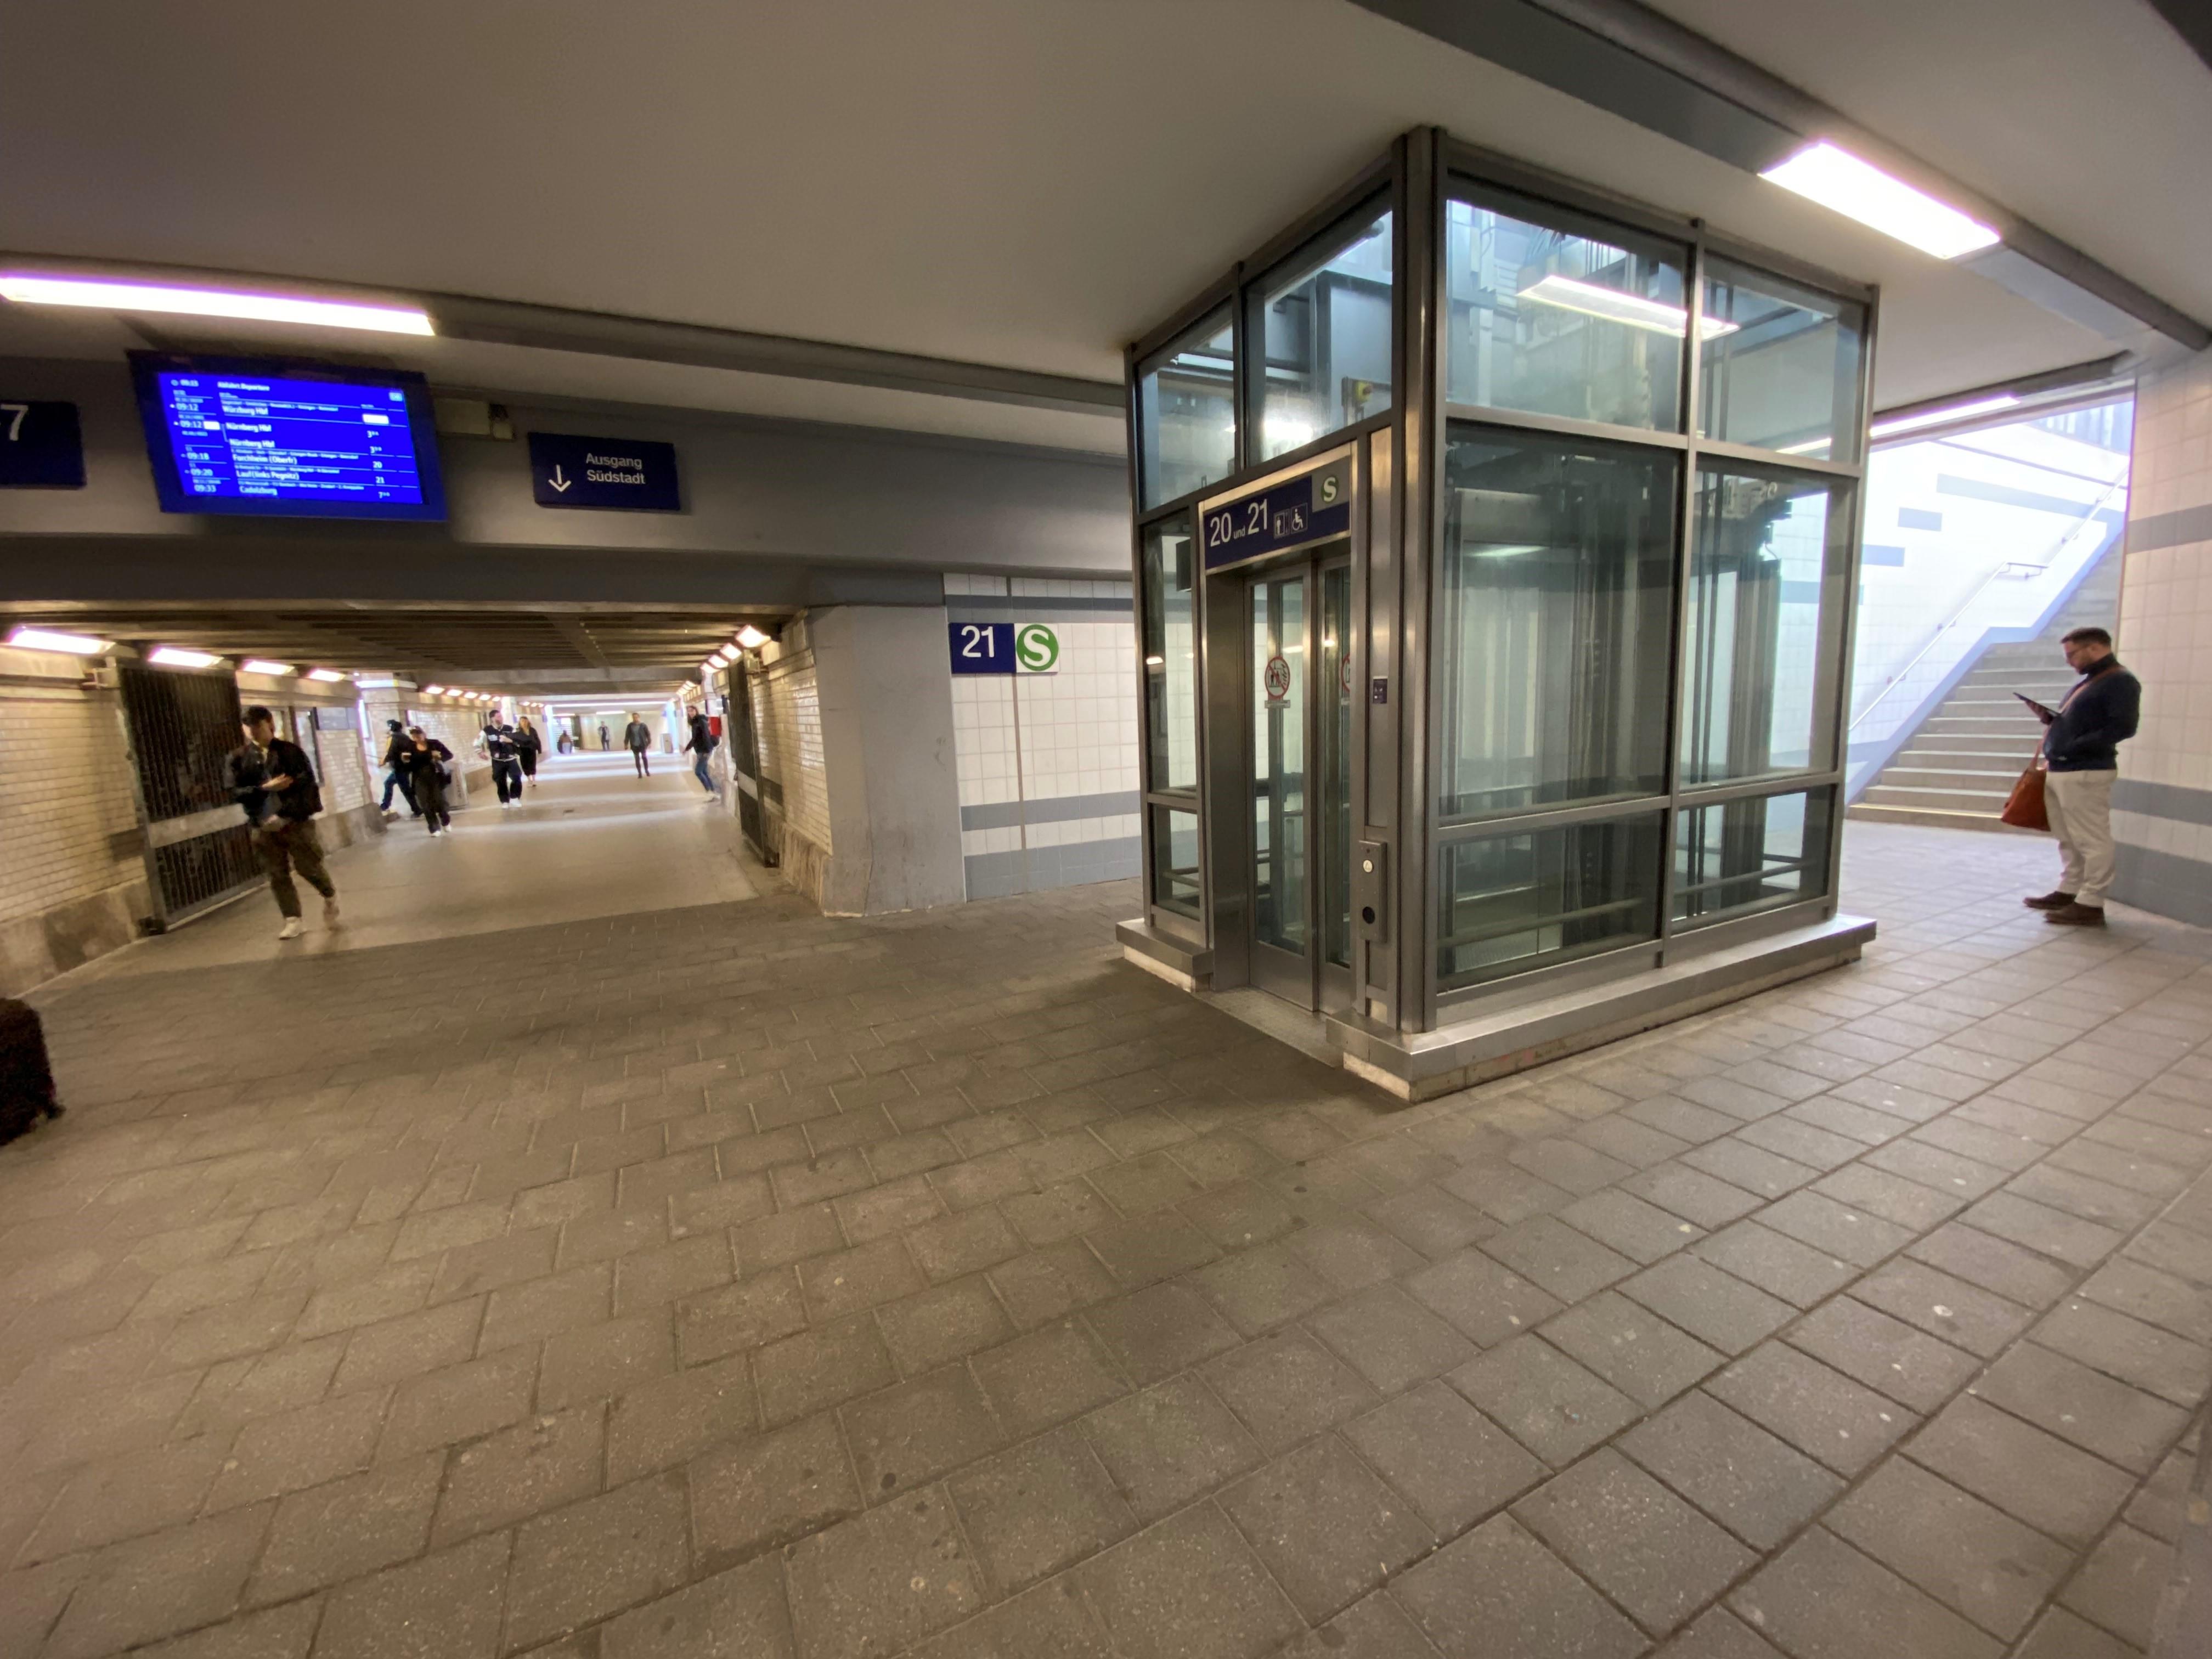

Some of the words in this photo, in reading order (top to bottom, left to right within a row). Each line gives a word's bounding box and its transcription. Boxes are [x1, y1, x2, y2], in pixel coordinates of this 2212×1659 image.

[176, 403, 199, 411] 09:12
[222, 405, 255, 416] Würzburg
[255, 407, 269, 415] Hbf
[179, 420, 202, 428] 09:12
[225, 422, 258, 433] Nürnberg
[229, 438, 262, 449] Nürnberg
[262, 440, 275, 448] Hbf
[233, 454, 268, 462] Forchheim
[585, 453, 642, 470] Ausgang
[586, 469, 646, 485] Südstadt
[1323, 477, 1337, 502] S
[1210, 512, 1232, 547] 20
[1233, 526, 1246, 539] und
[1247, 498, 1268, 535] 21
[961, 625, 995, 658] 21
[1023, 629, 1052, 667] S
